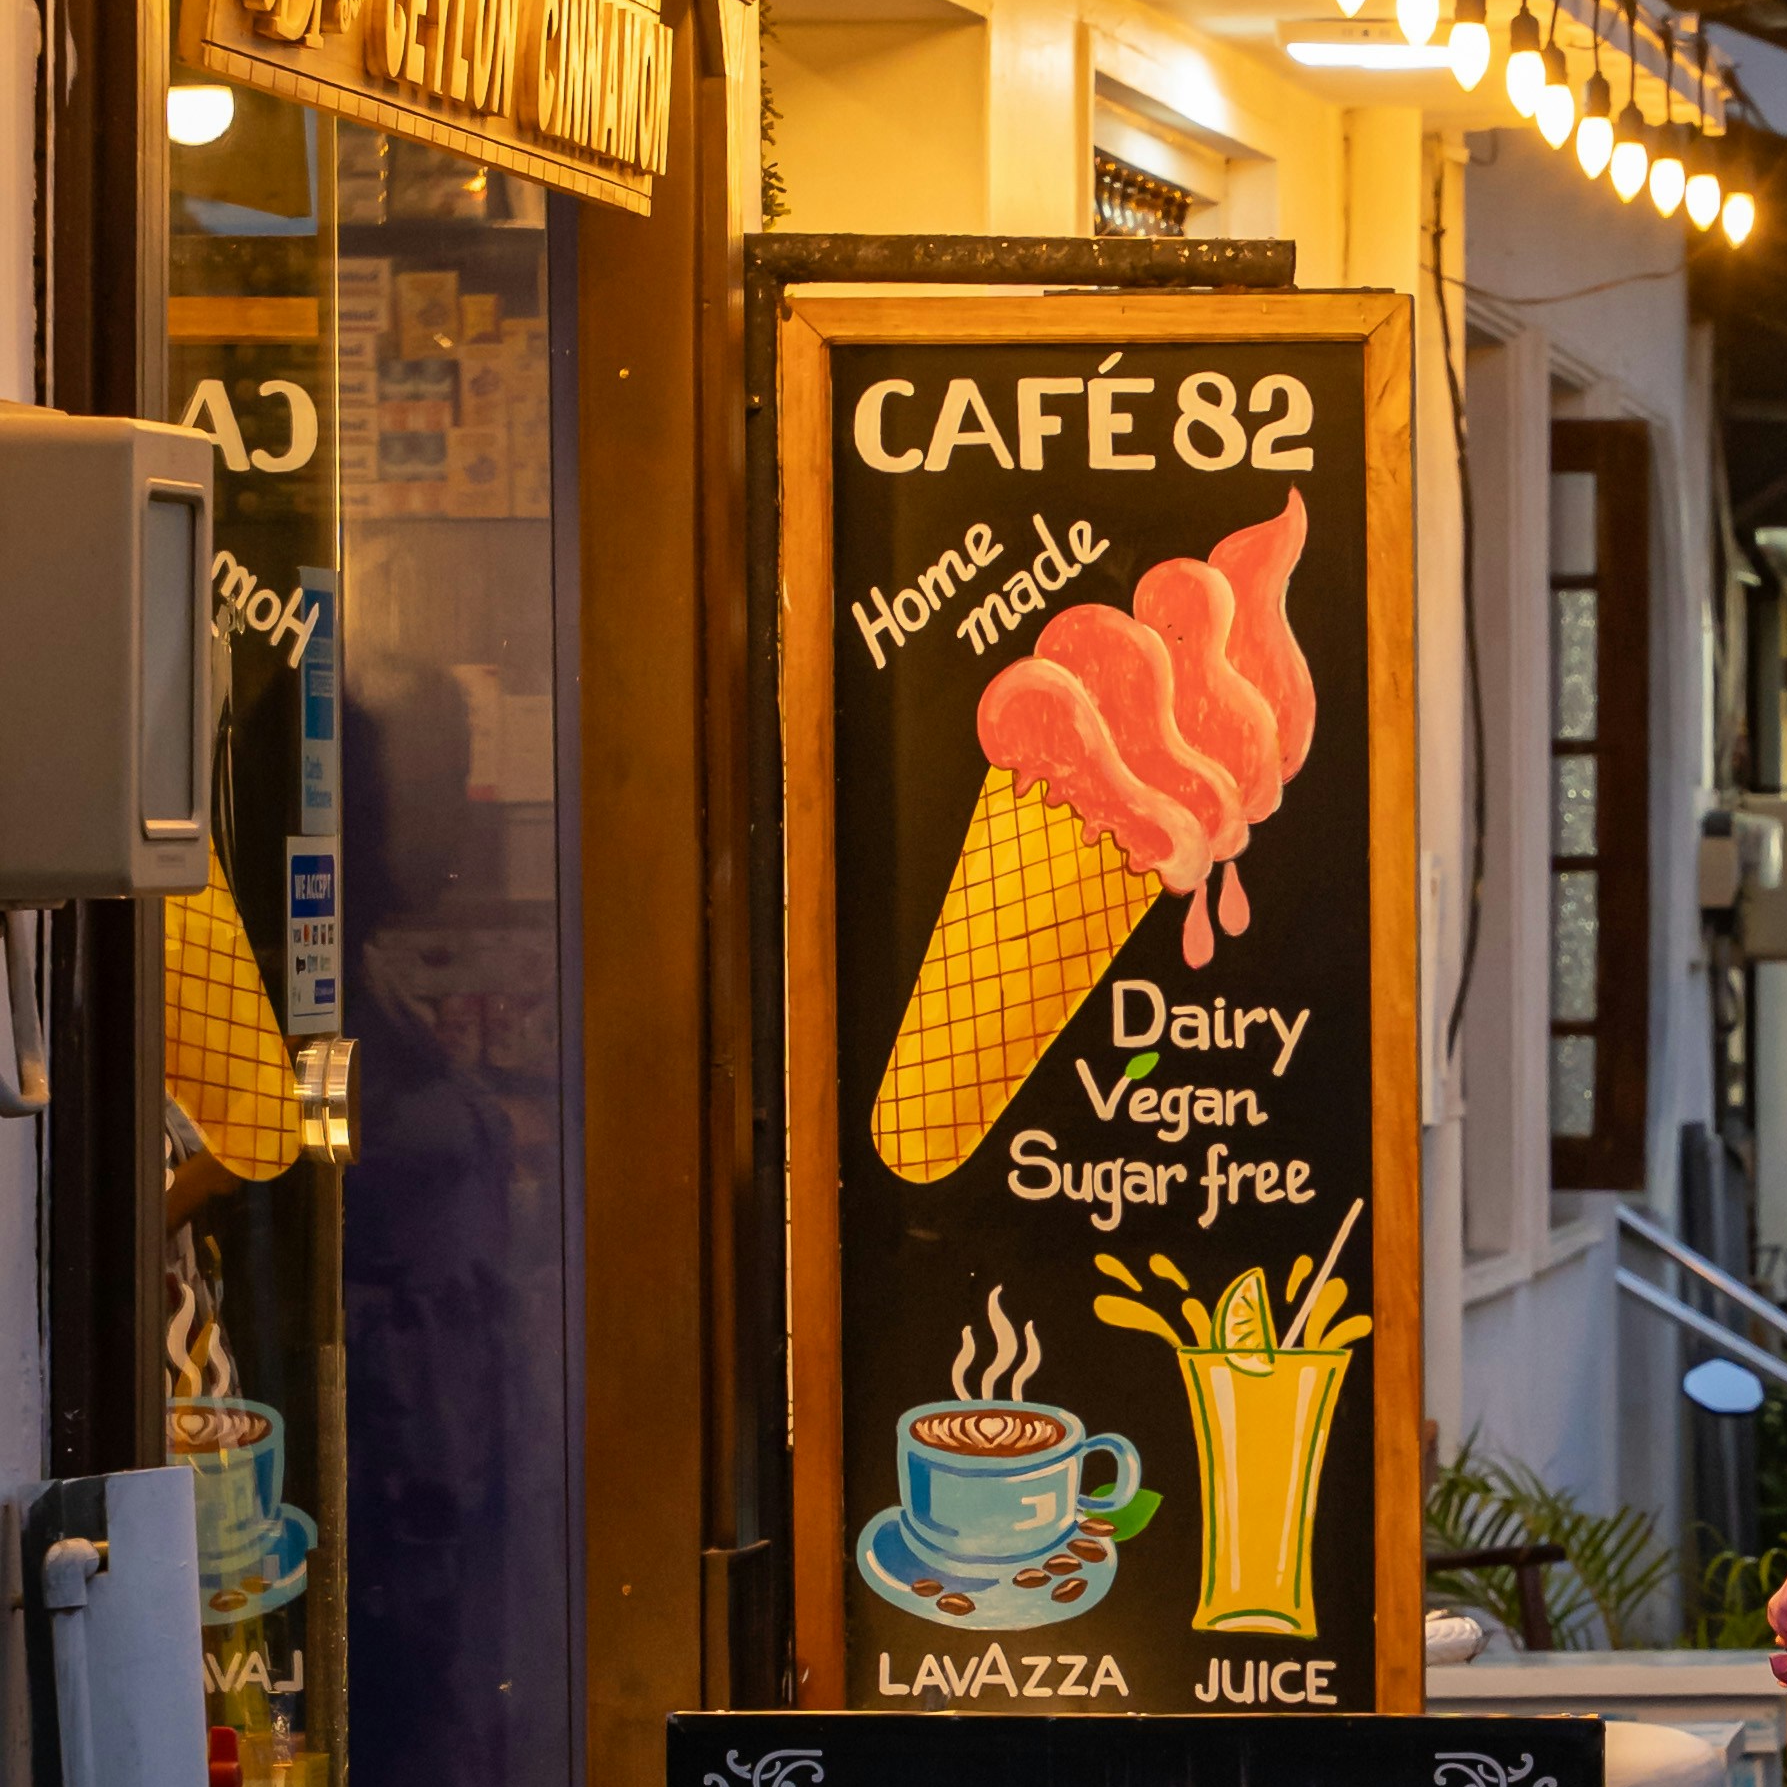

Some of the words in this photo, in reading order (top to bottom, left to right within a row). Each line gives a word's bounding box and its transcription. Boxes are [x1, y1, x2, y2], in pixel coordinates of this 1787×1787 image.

[853, 351, 1157, 474] CAFÉ
[1172, 371, 1315, 473] 82
[851, 522, 1006, 670] Home
[955, 512, 1111, 656] made
[294, 873, 306, 900] WE
[306, 873, 331, 900] ACCEPT
[1111, 978, 1311, 1078] Dairy
[1075, 1053, 1269, 1142] Vegan
[1008, 1129, 1188, 1232] Sugar
[1199, 1143, 1317, 1229] free
[878, 1641, 1130, 1699] LAVAZZA
[1194, 1657, 1339, 1705] JUICE
